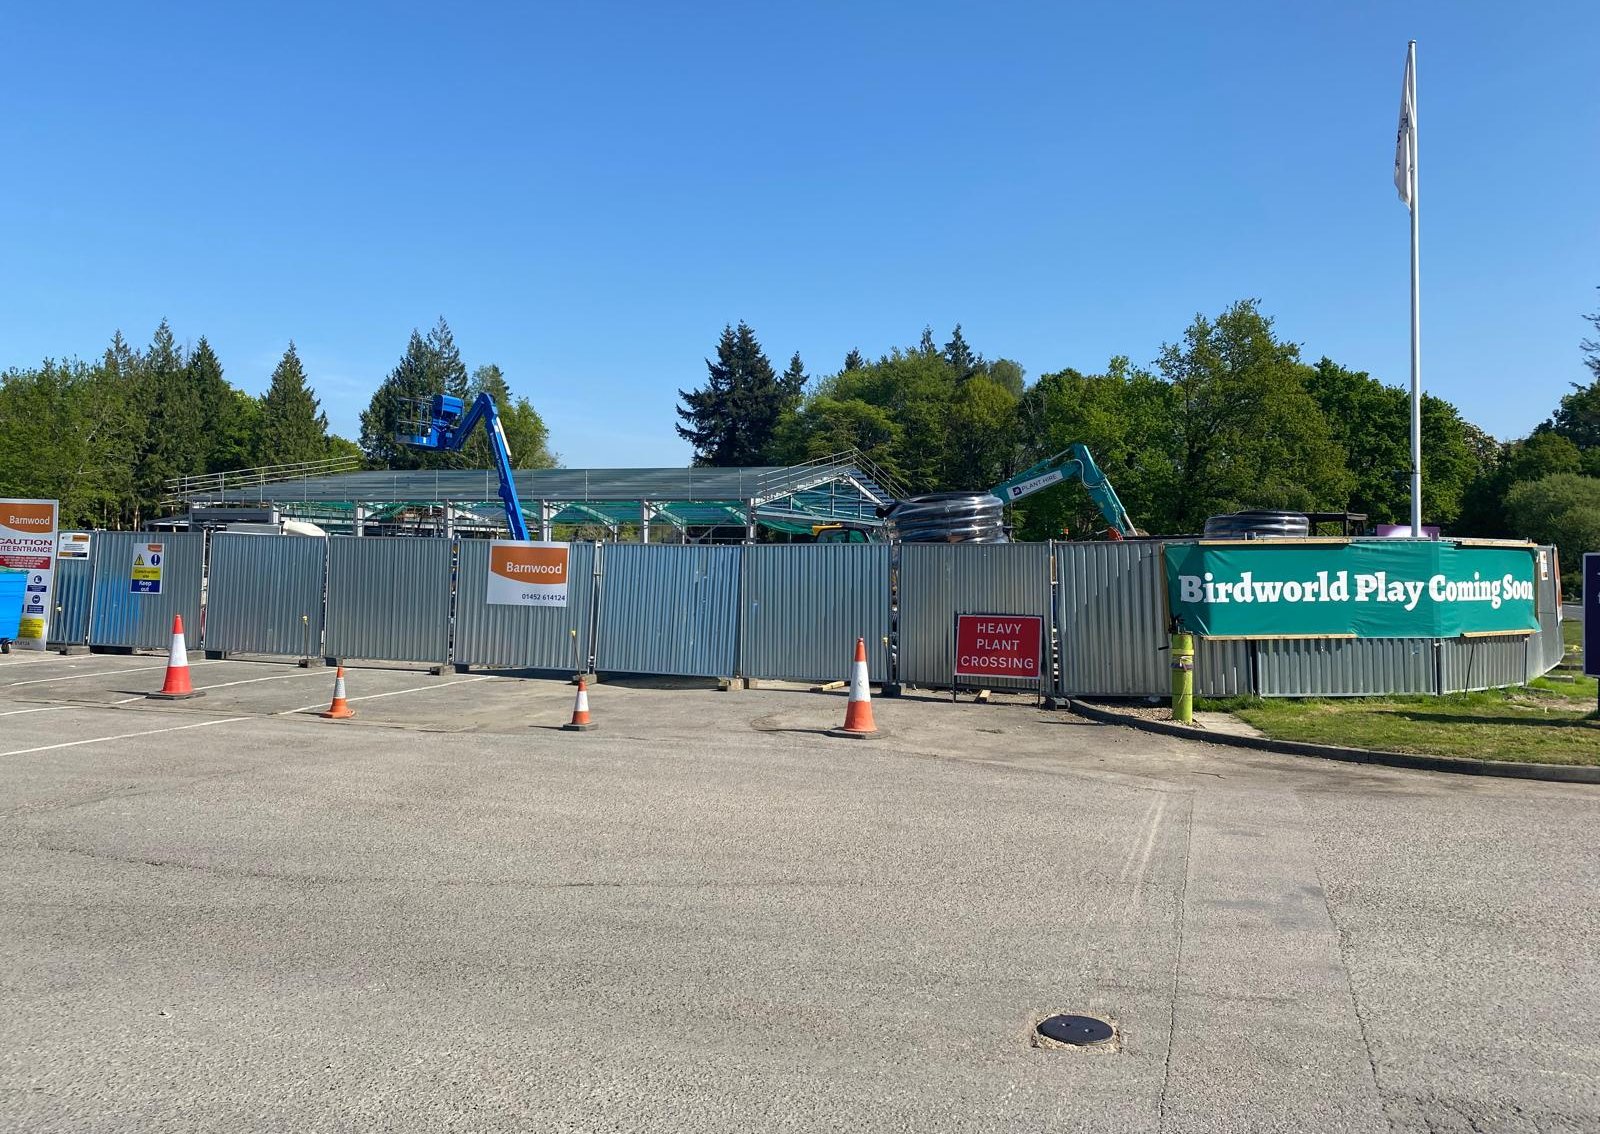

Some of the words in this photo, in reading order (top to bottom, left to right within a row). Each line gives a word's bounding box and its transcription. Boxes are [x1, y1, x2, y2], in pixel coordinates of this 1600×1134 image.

[1021, 480, 1041, 491] PLANT
[1042, 474, 1057, 484] HIRE
[9, 515, 50, 525] Barnwood
[12, 545, 52, 553] ENTRANCE
[506, 562, 562, 574] Barnwood
[1178, 570, 1350, 603] Birdworld
[1354, 571, 1424, 611] Play
[1428, 571, 1501, 610] Coming
[1502, 573, 1534, 601] Soon
[977, 623, 1022, 634] HEAVY
[976, 638, 1020, 651] PLANT
[960, 655, 1034, 669] CROSSING
